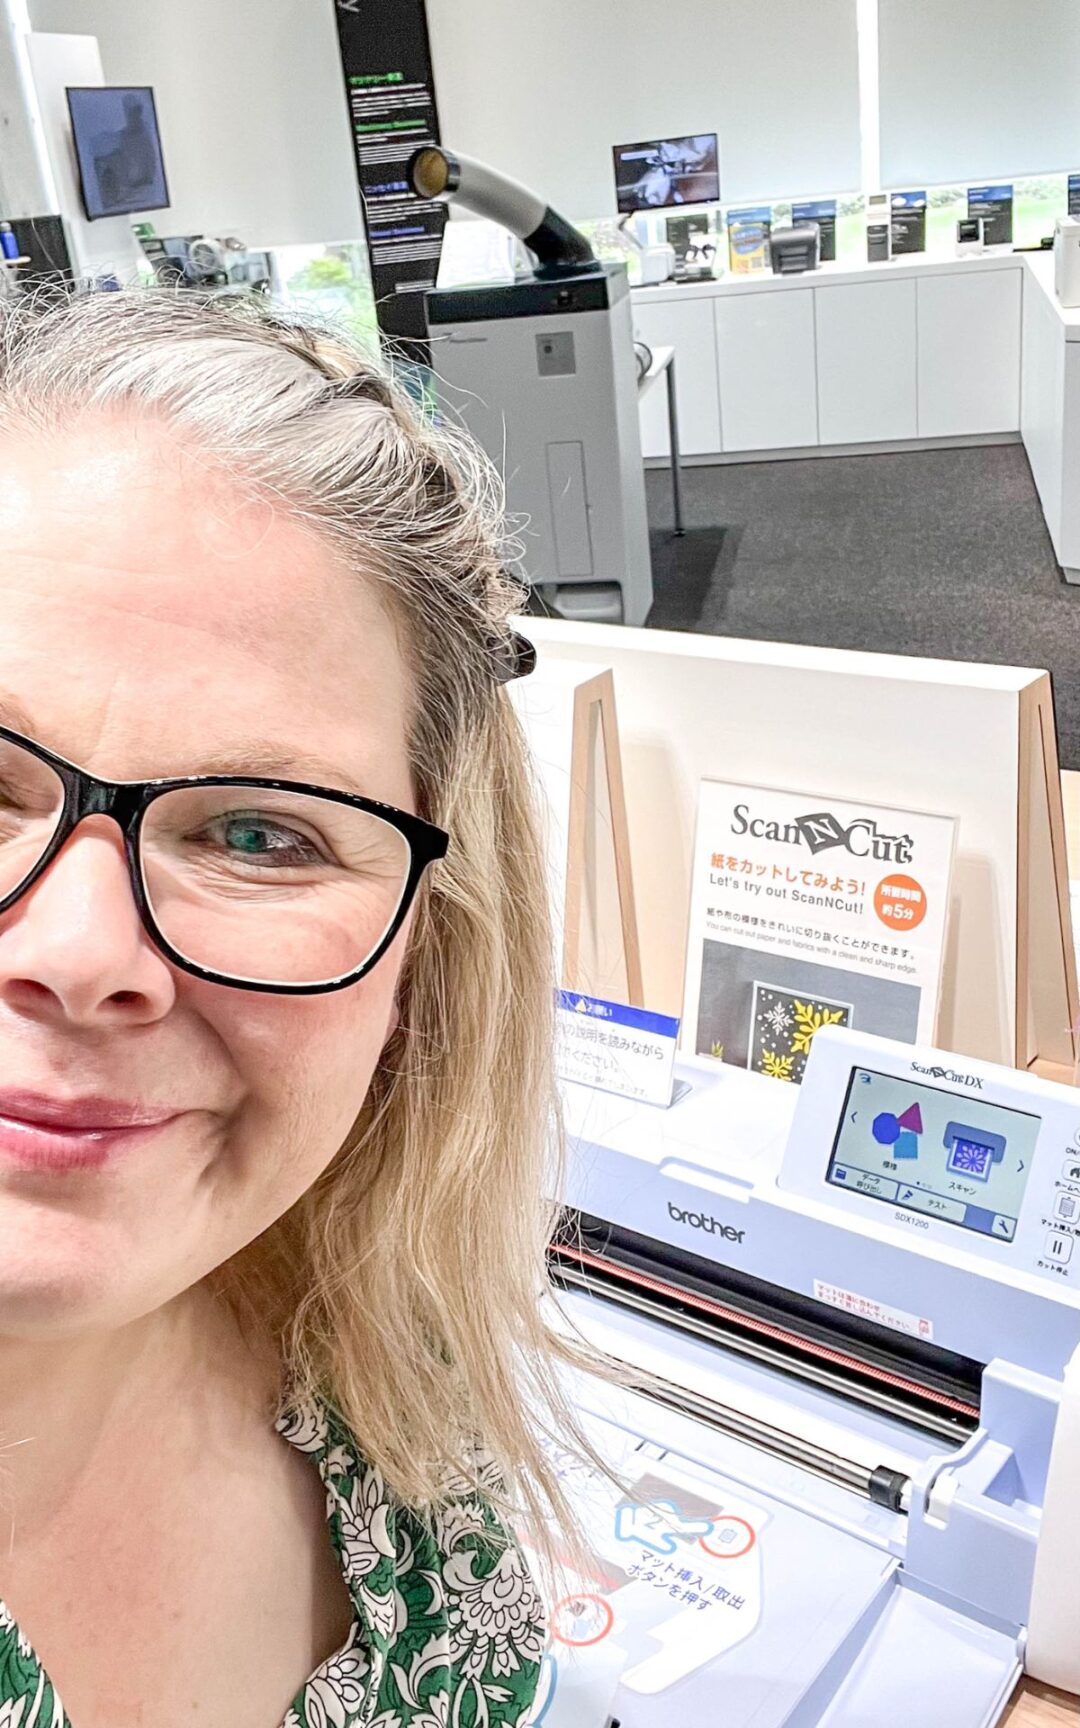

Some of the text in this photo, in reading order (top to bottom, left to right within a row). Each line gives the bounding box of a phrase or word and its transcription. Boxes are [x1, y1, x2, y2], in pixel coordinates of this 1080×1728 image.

[731, 803, 915, 864] ScanNCut
[709, 873, 864, 915] Let's try out ScanNCut!
[706, 920, 719, 930] You
[949, 1181, 977, 1196] スキャン
[928, 1199, 948, 1210] テスト
[667, 1201, 746, 1244] brother
[894, 1212, 929, 1230] SDX1200
[641, 1549, 746, 1610] マット挿入/取出
